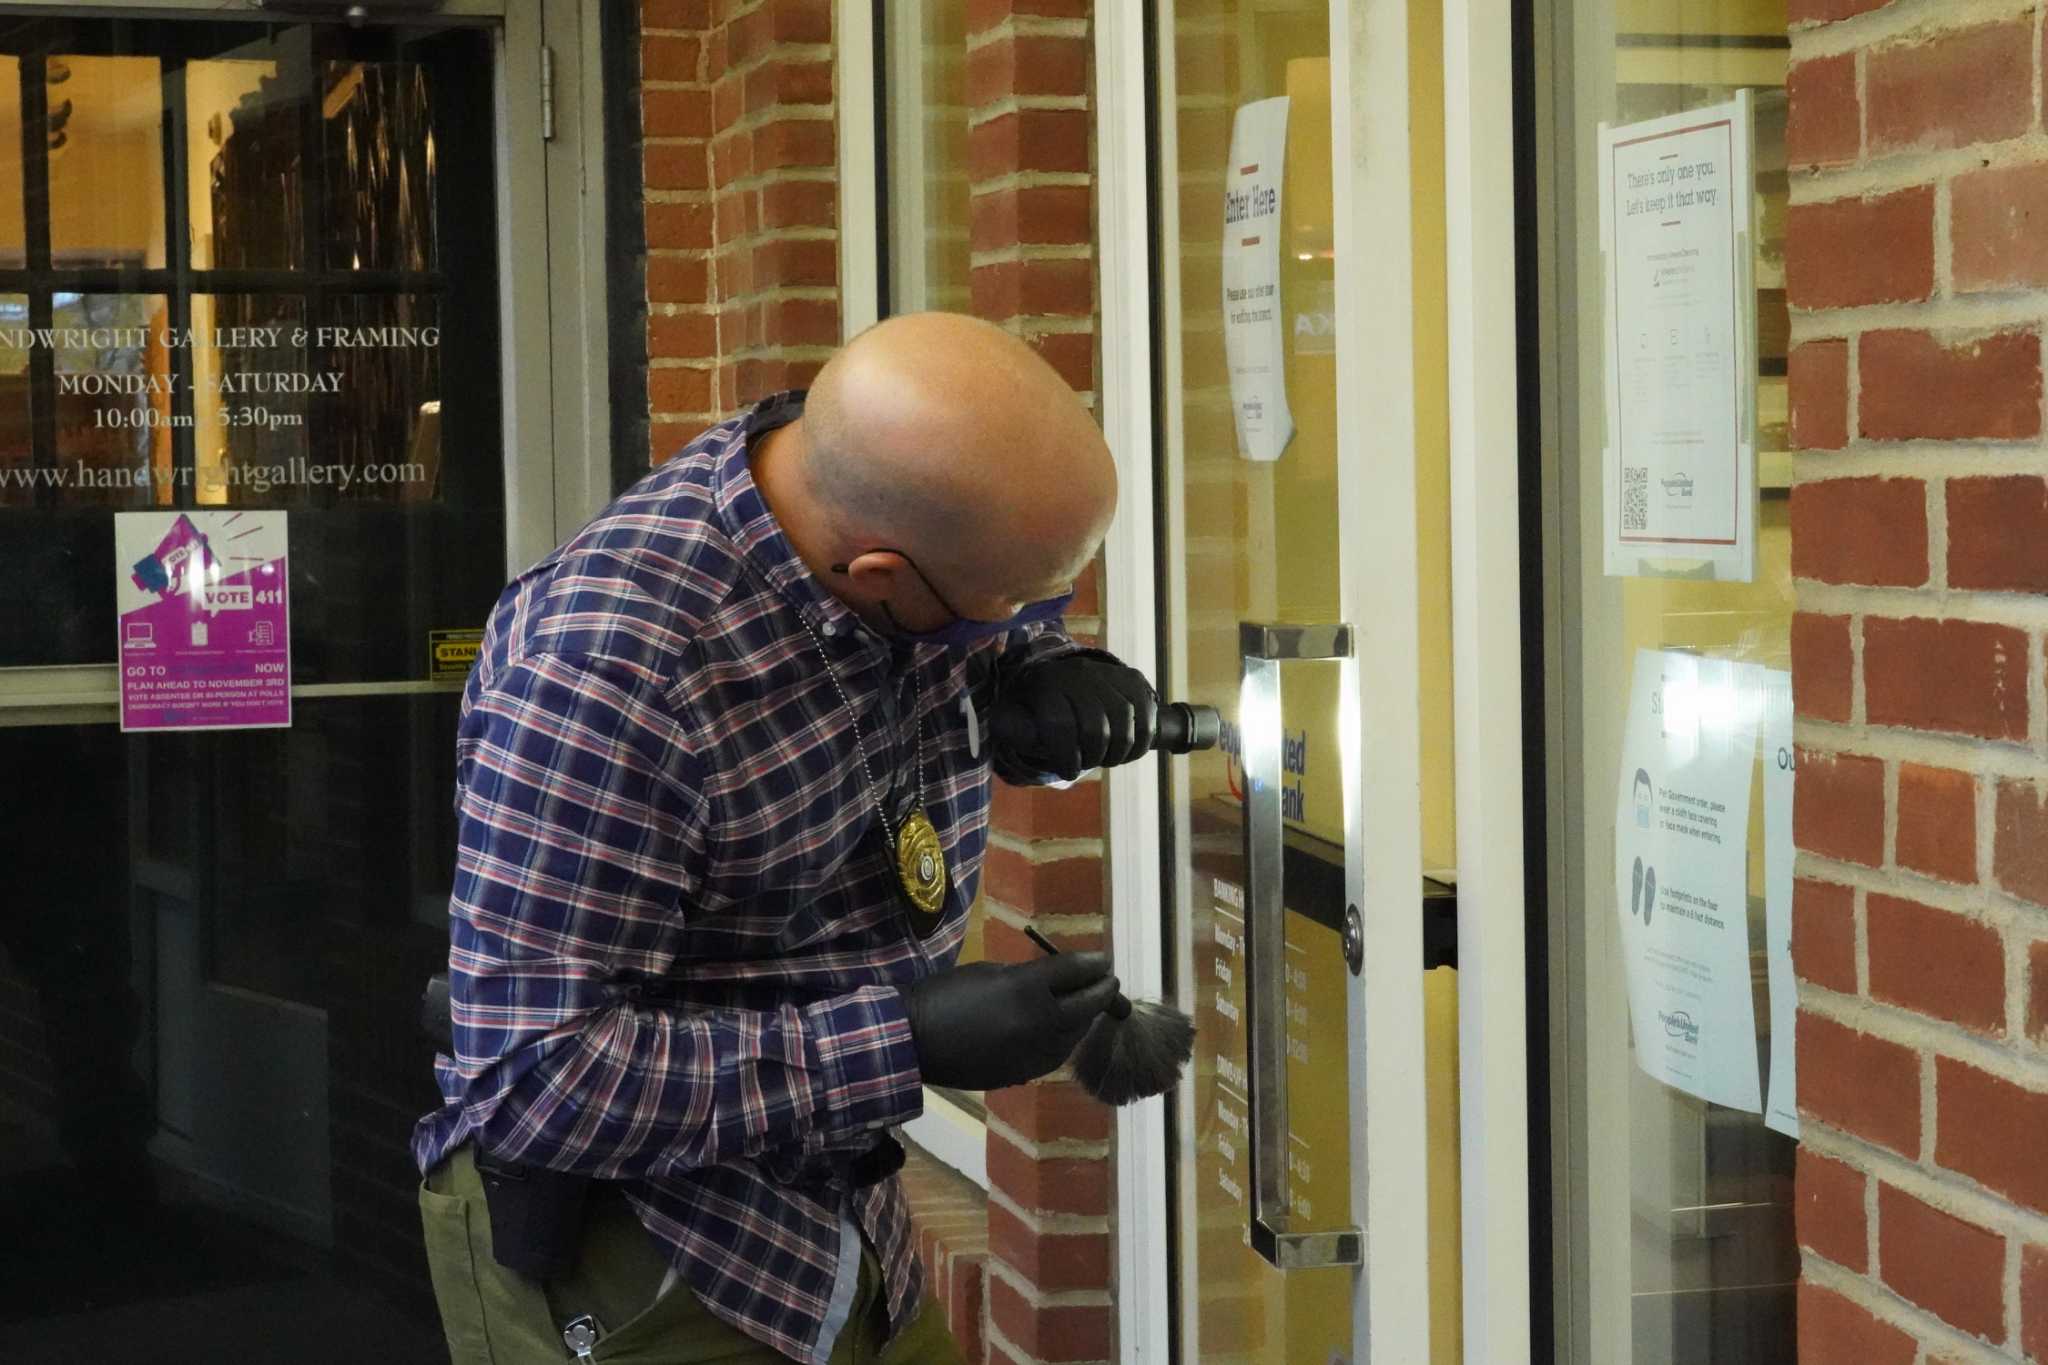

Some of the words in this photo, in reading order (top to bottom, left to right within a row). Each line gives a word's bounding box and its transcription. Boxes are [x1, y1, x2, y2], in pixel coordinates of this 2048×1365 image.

[1627, 169, 1655, 189] There's
[1657, 166, 1675, 185] only
[1677, 165, 1694, 179] one
[1225, 190, 1249, 224] Enter
[1253, 184, 1275, 217] Here
[1676, 188, 1694, 207] that
[160, 327, 283, 349] GALERY
[291, 328, 308, 348] &
[317, 327, 441, 347] FRAMING
[59, 374, 179, 396] MONDAY
[94, 408, 194, 429] 10:00am
[217, 406, 303, 431] 5:30pm
[0, 456, 426, 493] ww.handwrghtgallery.com
[204, 591, 250, 604] VOTE
[255, 589, 283, 605] 411
[440, 647, 478, 657] STAN
[127, 666, 146, 677] GO
[148, 665, 166, 677] TO
[255, 663, 284, 674] NOW
[127, 681, 154, 690] PLAN
[156, 680, 190, 690] AHEAD
[193, 680, 207, 689] TO
[208, 679, 263, 689] NOVEMBER
[1778, 747, 1796, 771] Ou
[1282, 779, 1304, 822] ank
